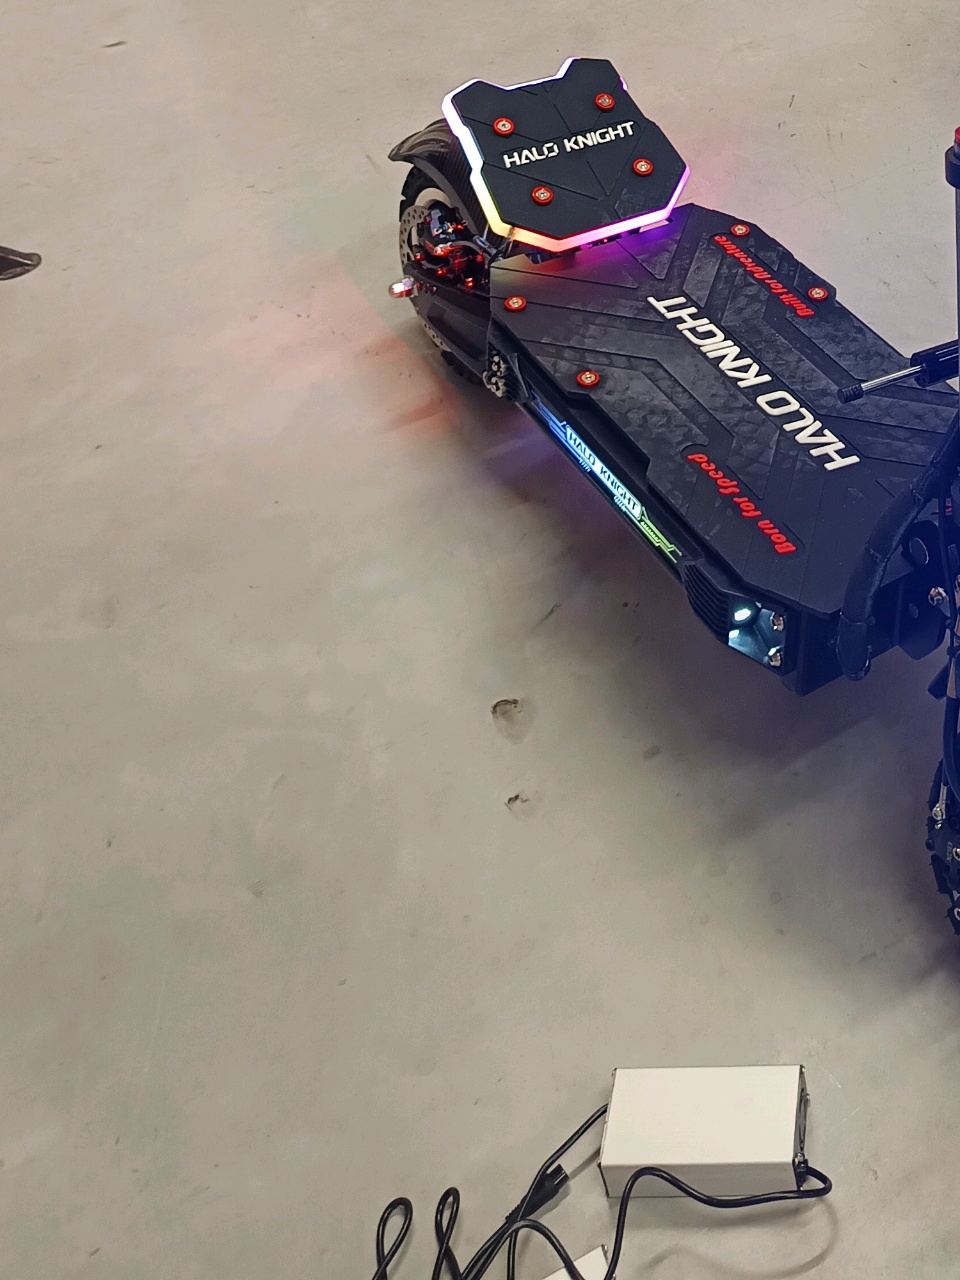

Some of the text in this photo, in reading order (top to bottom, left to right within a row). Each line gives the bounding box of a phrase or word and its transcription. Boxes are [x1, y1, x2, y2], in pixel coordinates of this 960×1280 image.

[503, 121, 636, 169] HALO KNIGHT
[780, 294, 815, 317] Built
[647, 296, 860, 471] HALO KNIGHT
[569, 432, 639, 511] HALO KNIGHT
[687, 453, 797, 555] Born for Speed
